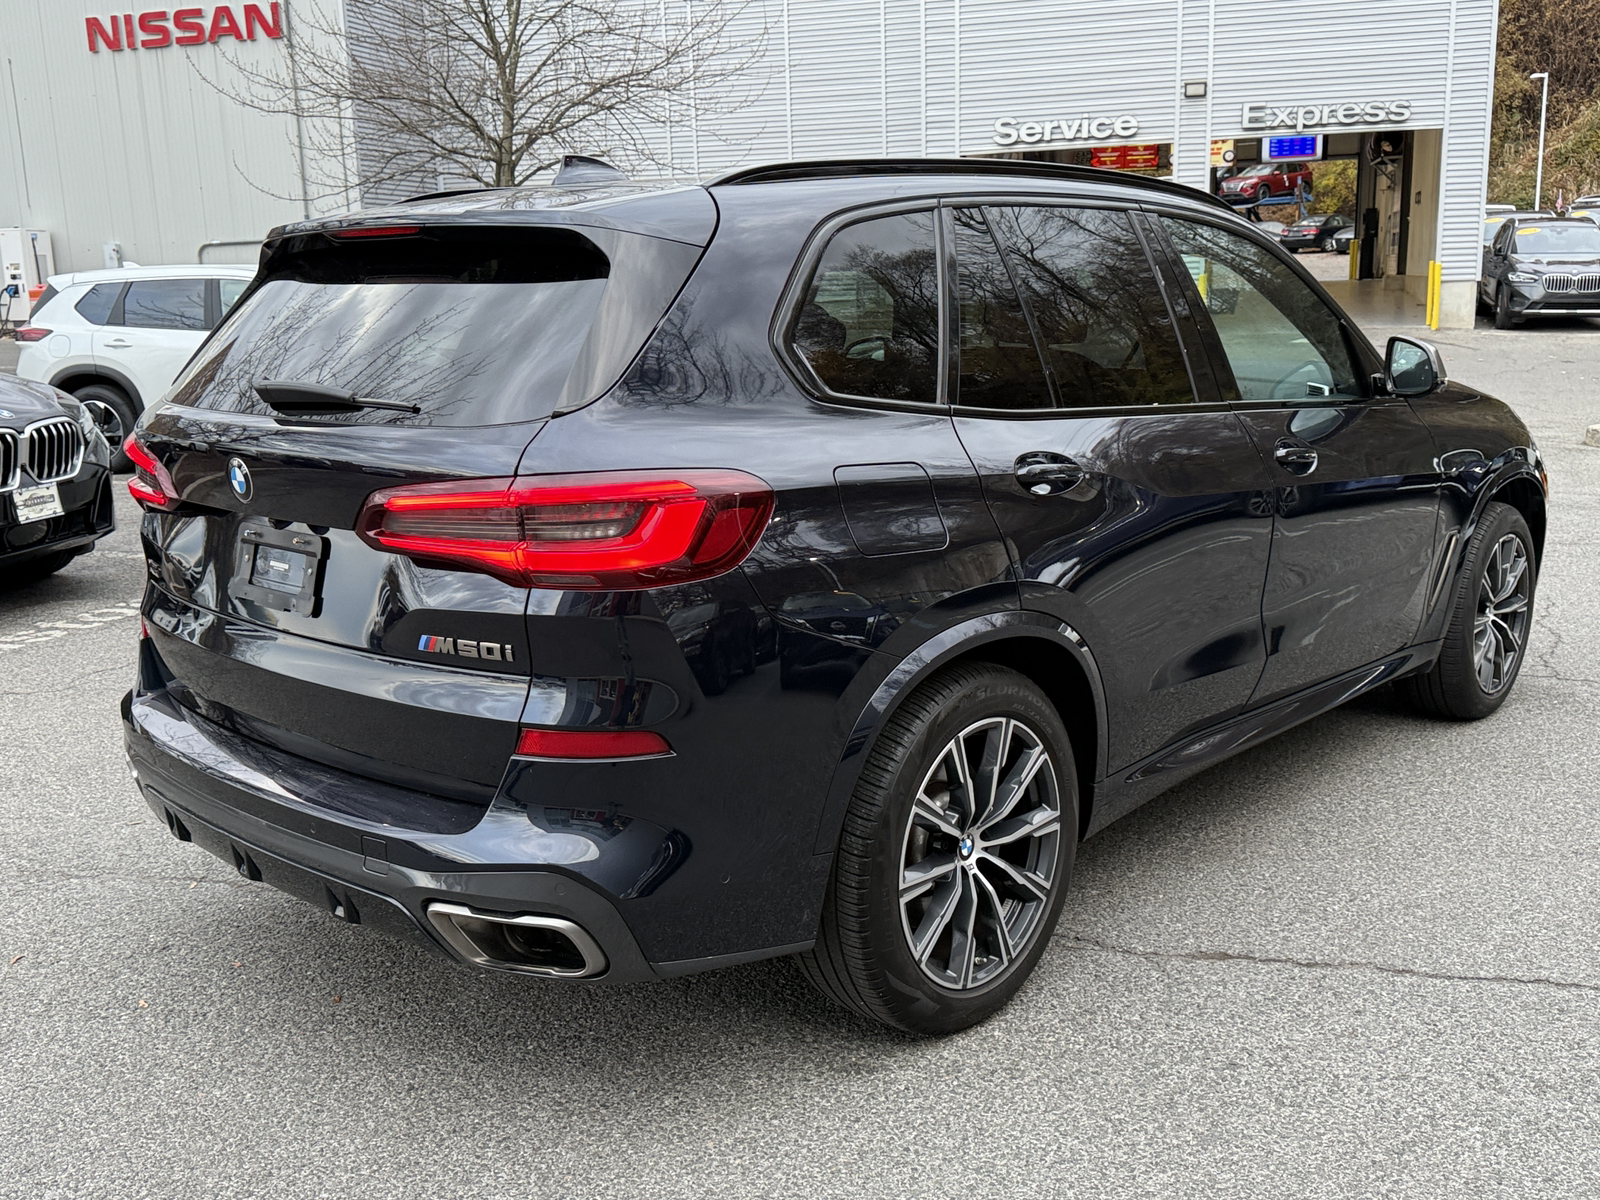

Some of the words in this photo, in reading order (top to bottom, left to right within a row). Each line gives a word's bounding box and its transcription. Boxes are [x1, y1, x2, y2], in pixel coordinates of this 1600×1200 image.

[85, 1, 283, 53] NISSAN
[992, 113, 1139, 145] Service
[1241, 99, 1412, 133] Express
[417, 634, 514, 662] M50i
